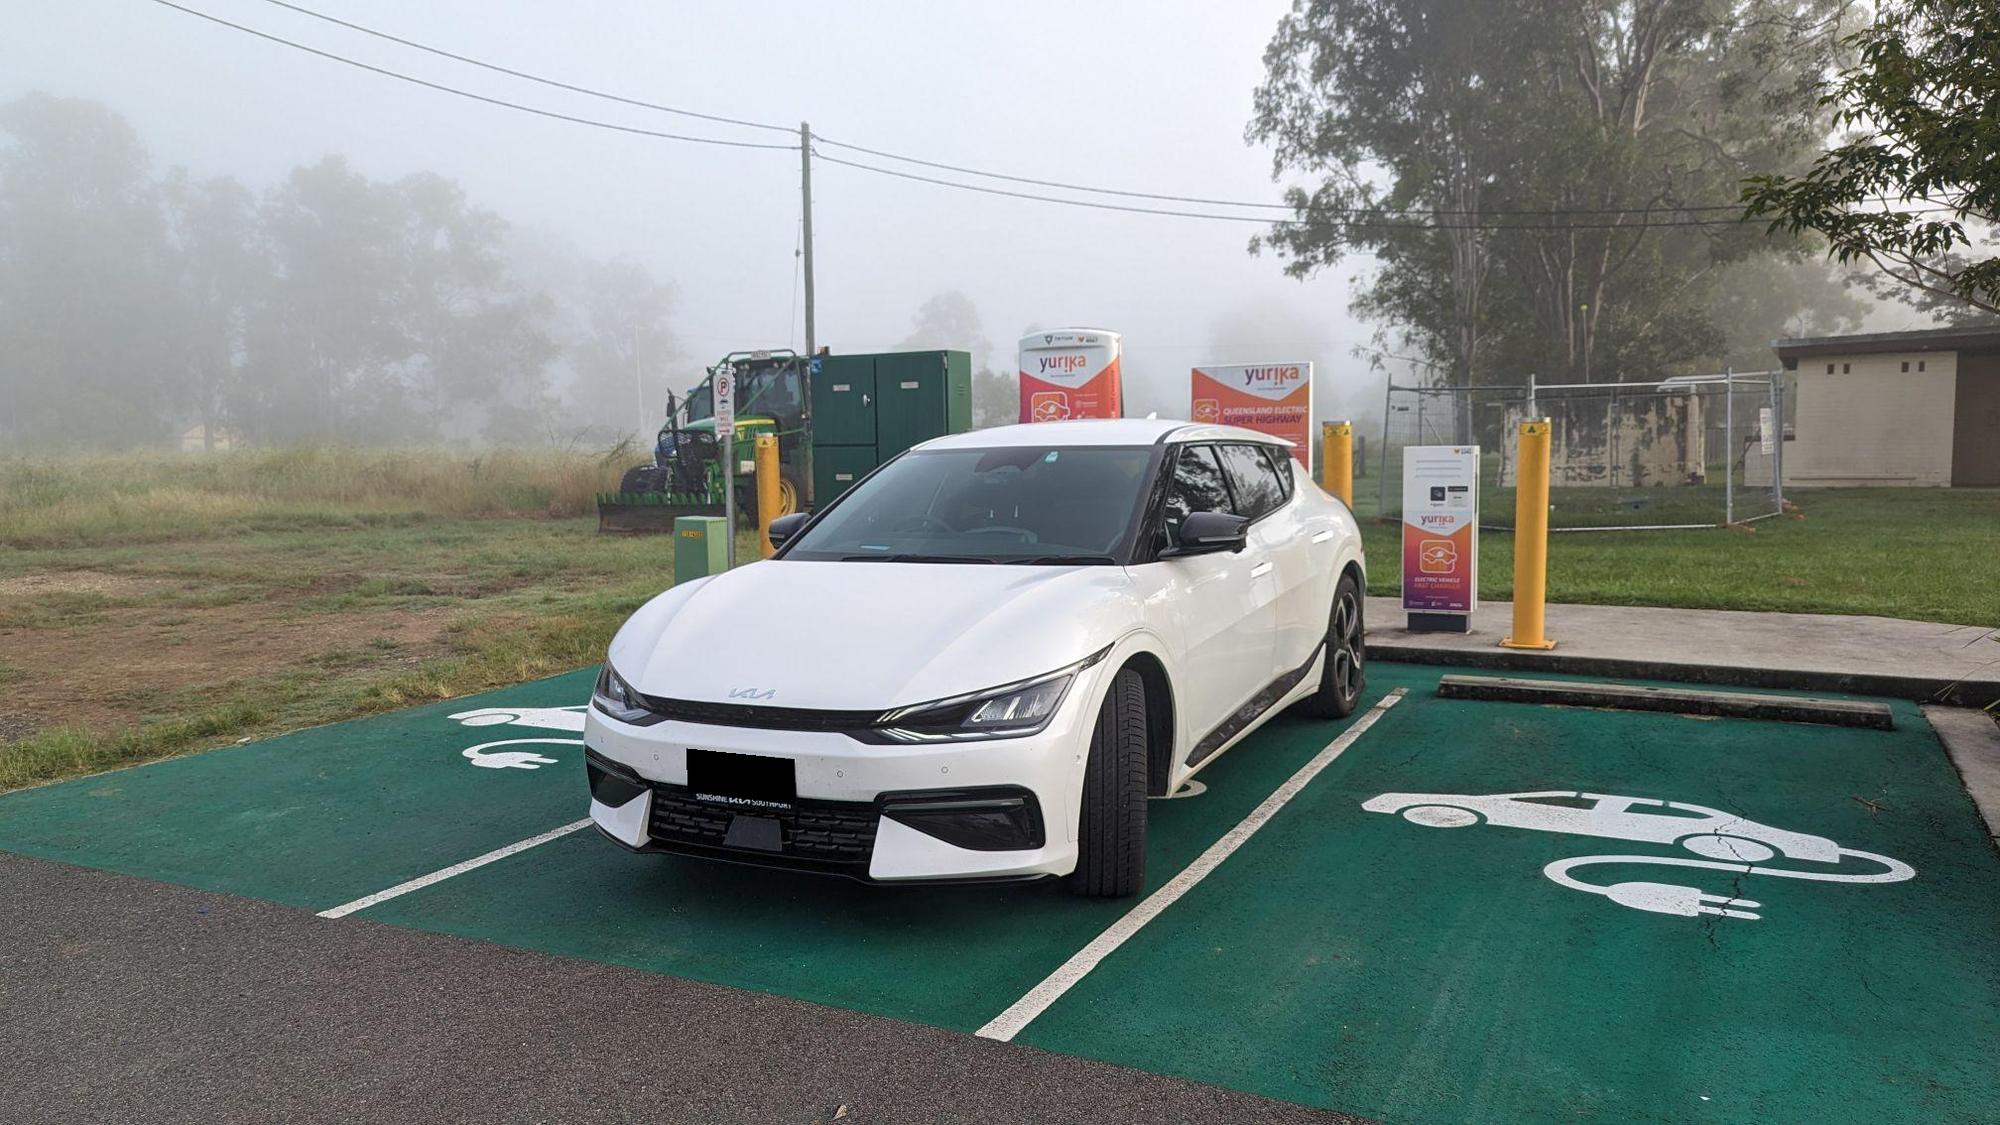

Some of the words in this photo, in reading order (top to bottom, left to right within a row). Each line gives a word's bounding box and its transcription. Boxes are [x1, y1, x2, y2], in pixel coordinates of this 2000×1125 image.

[1040, 355, 1086, 373] yurika
[1245, 367, 1299, 385] yurika
[1223, 407, 1273, 415] QUEENSLAND
[1274, 406, 1308, 414] ELECTRIC
[1224, 416, 1253, 425] SUPER
[1256, 415, 1302, 424] HIGHWAY
[1421, 515, 1455, 526] yurika
[696, 793, 728, 803] SUNSHINE
